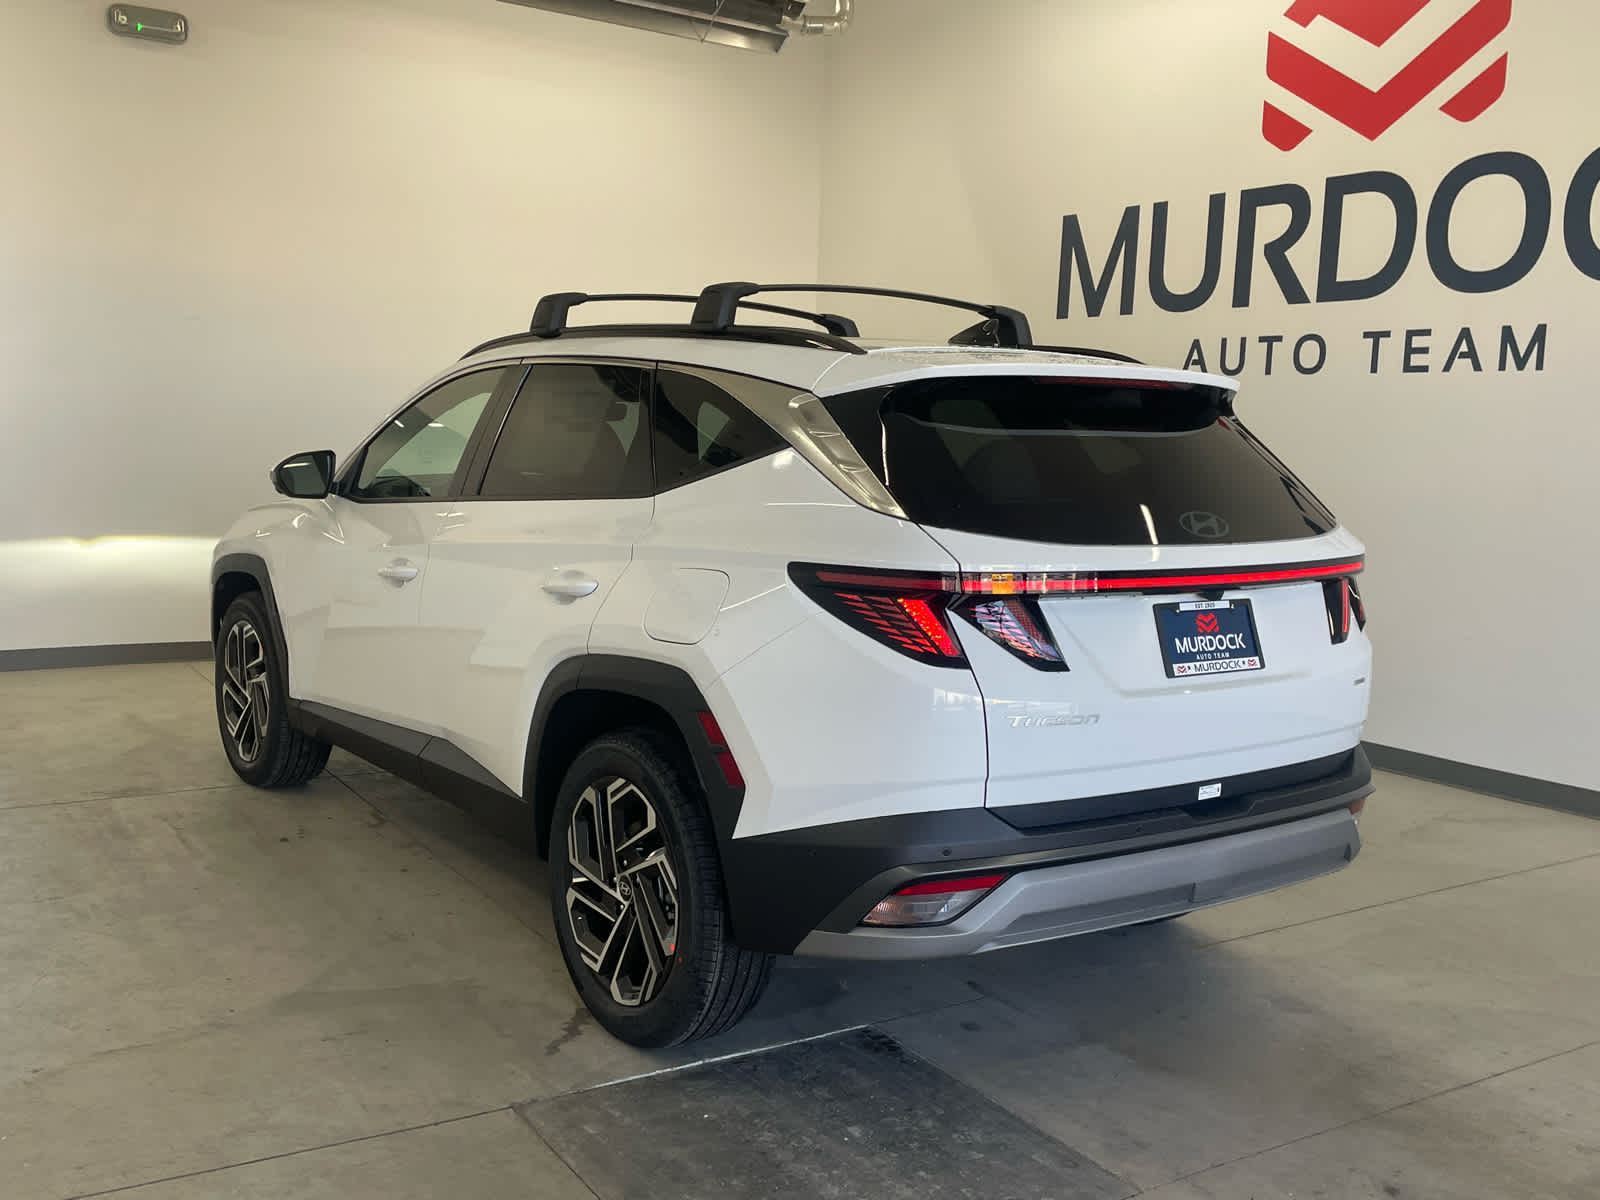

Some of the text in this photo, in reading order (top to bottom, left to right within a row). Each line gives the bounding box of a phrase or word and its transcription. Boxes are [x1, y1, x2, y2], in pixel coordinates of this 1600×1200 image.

[1182, 323, 1547, 376] AUTO TEAM
[1174, 633, 1246, 653] MURDOCK
[1194, 660, 1240, 672] MURDOCK
